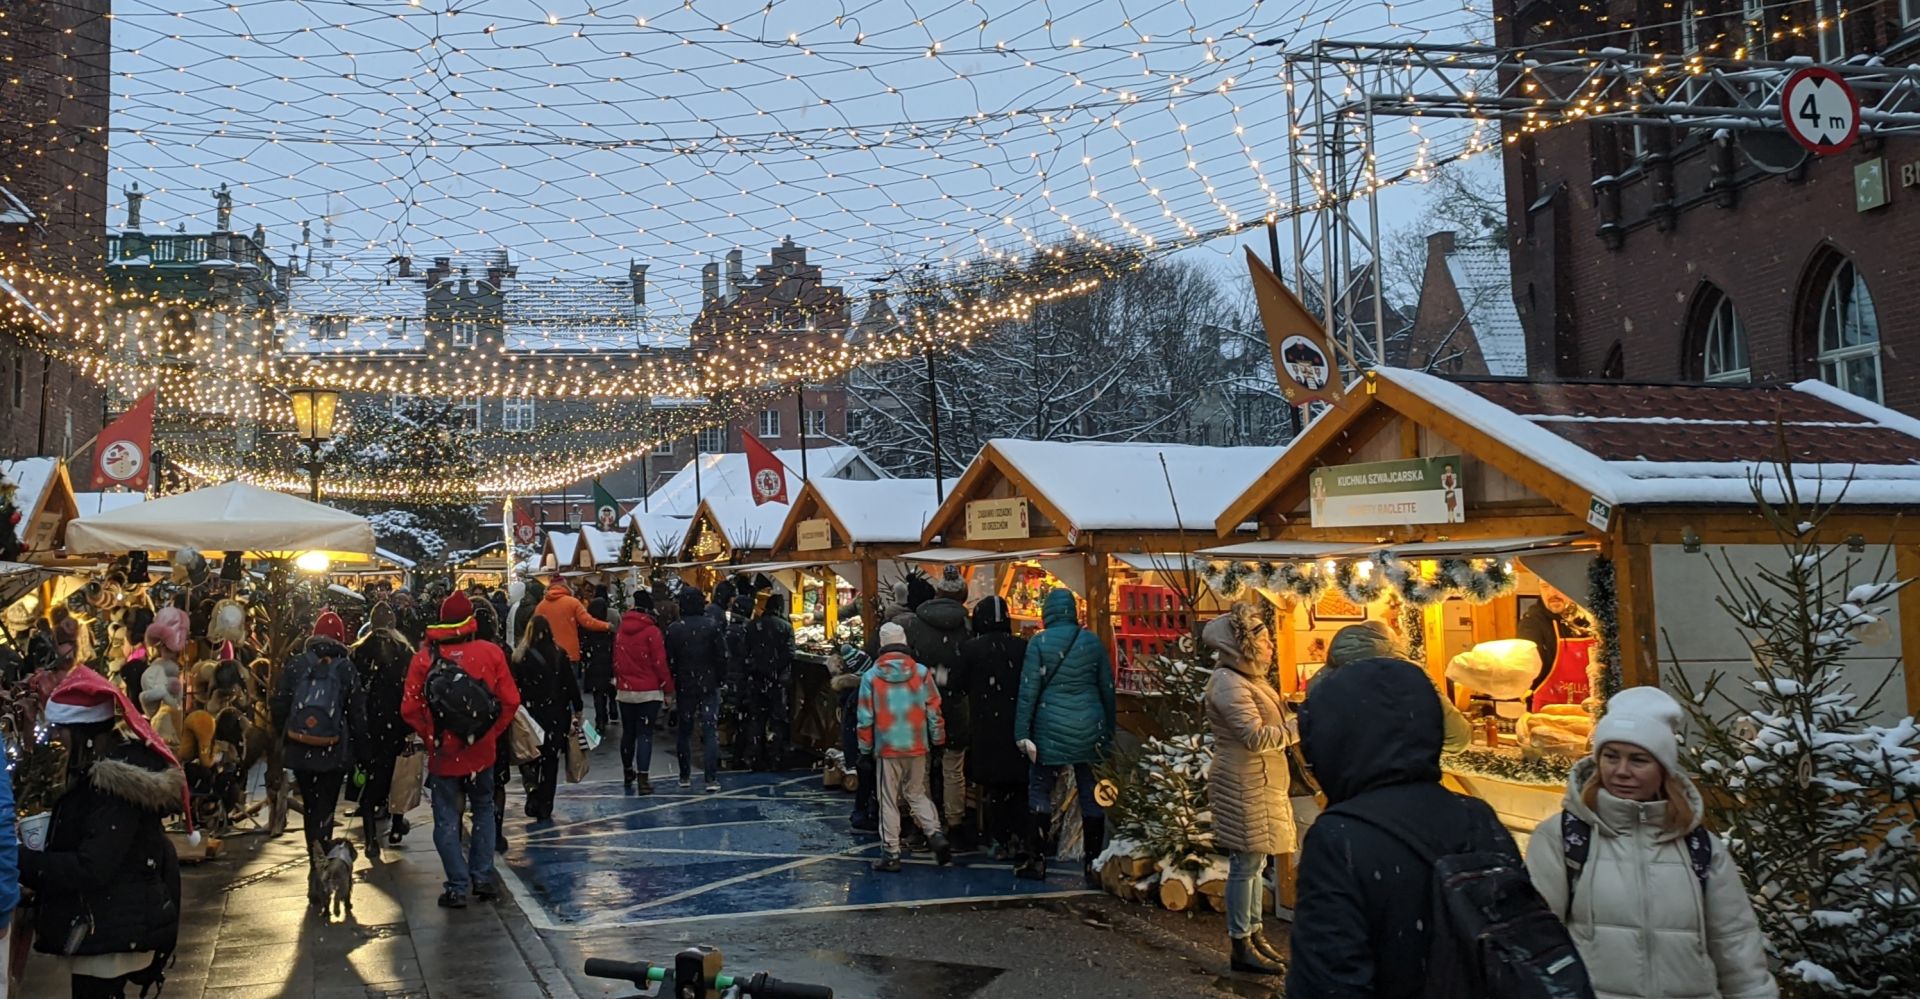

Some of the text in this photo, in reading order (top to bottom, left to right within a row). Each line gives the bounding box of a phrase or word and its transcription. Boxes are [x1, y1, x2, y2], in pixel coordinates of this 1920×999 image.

[1799, 93, 1845, 129] 4 m
[1337, 469, 1424, 487] KUCHNIA SZWAJCARSKA
[1594, 503, 1606, 516] 66
